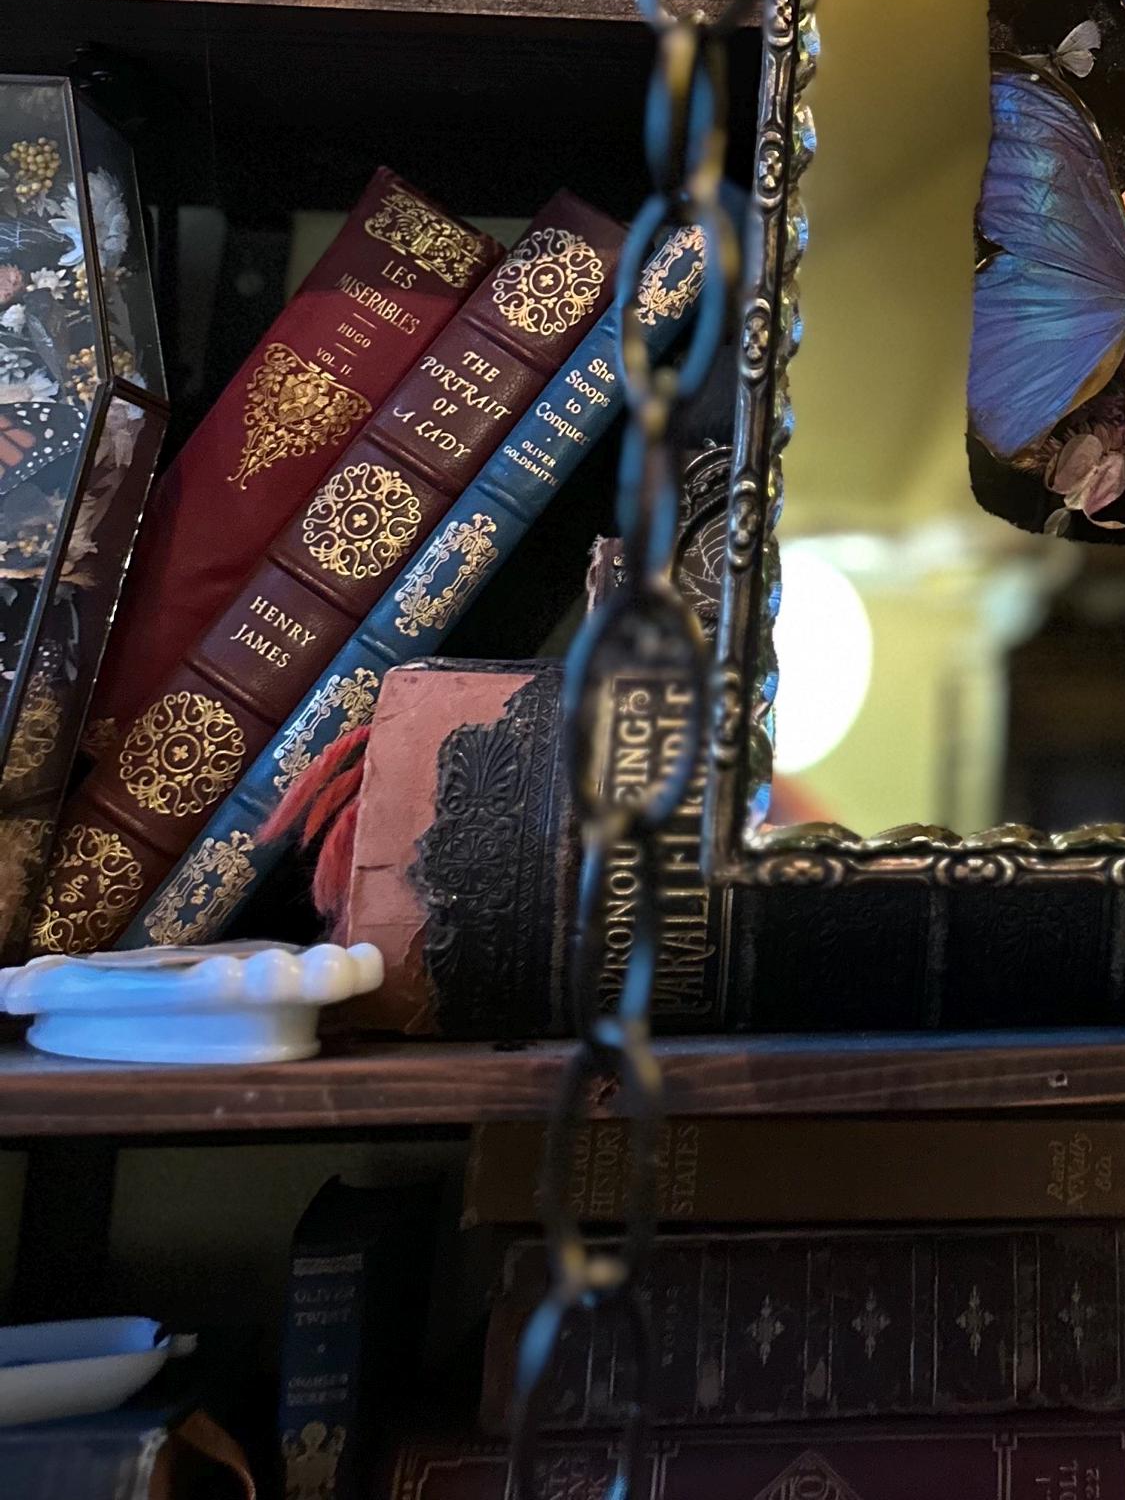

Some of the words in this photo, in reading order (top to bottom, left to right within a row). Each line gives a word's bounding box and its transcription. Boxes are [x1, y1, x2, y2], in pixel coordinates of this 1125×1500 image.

[381, 260, 417, 289] LES
[335, 273, 421, 334] MISERABLES
[336, 322, 372, 348] HUGO
[420, 356, 512, 420] PORTRAIT
[462, 351, 501, 382] THE
[587, 358, 616, 383] She
[432, 397, 459, 417] OF
[565, 369, 611, 408] Stoops
[565, 398, 582, 414] to
[393, 411, 416, 423] A
[415, 420, 472, 458] LADY
[535, 402, 591, 446] Conquer
[503, 445, 560, 487] GOLDSMITH
[521, 440, 557, 468] OLIVER
[249, 595, 317, 647] HENRY
[229, 623, 292, 668] JAMES
[591, 1123, 622, 1219] HISTORY
[672, 1124, 700, 1215] STATES
[1046, 1139, 1066, 1201] Rand
